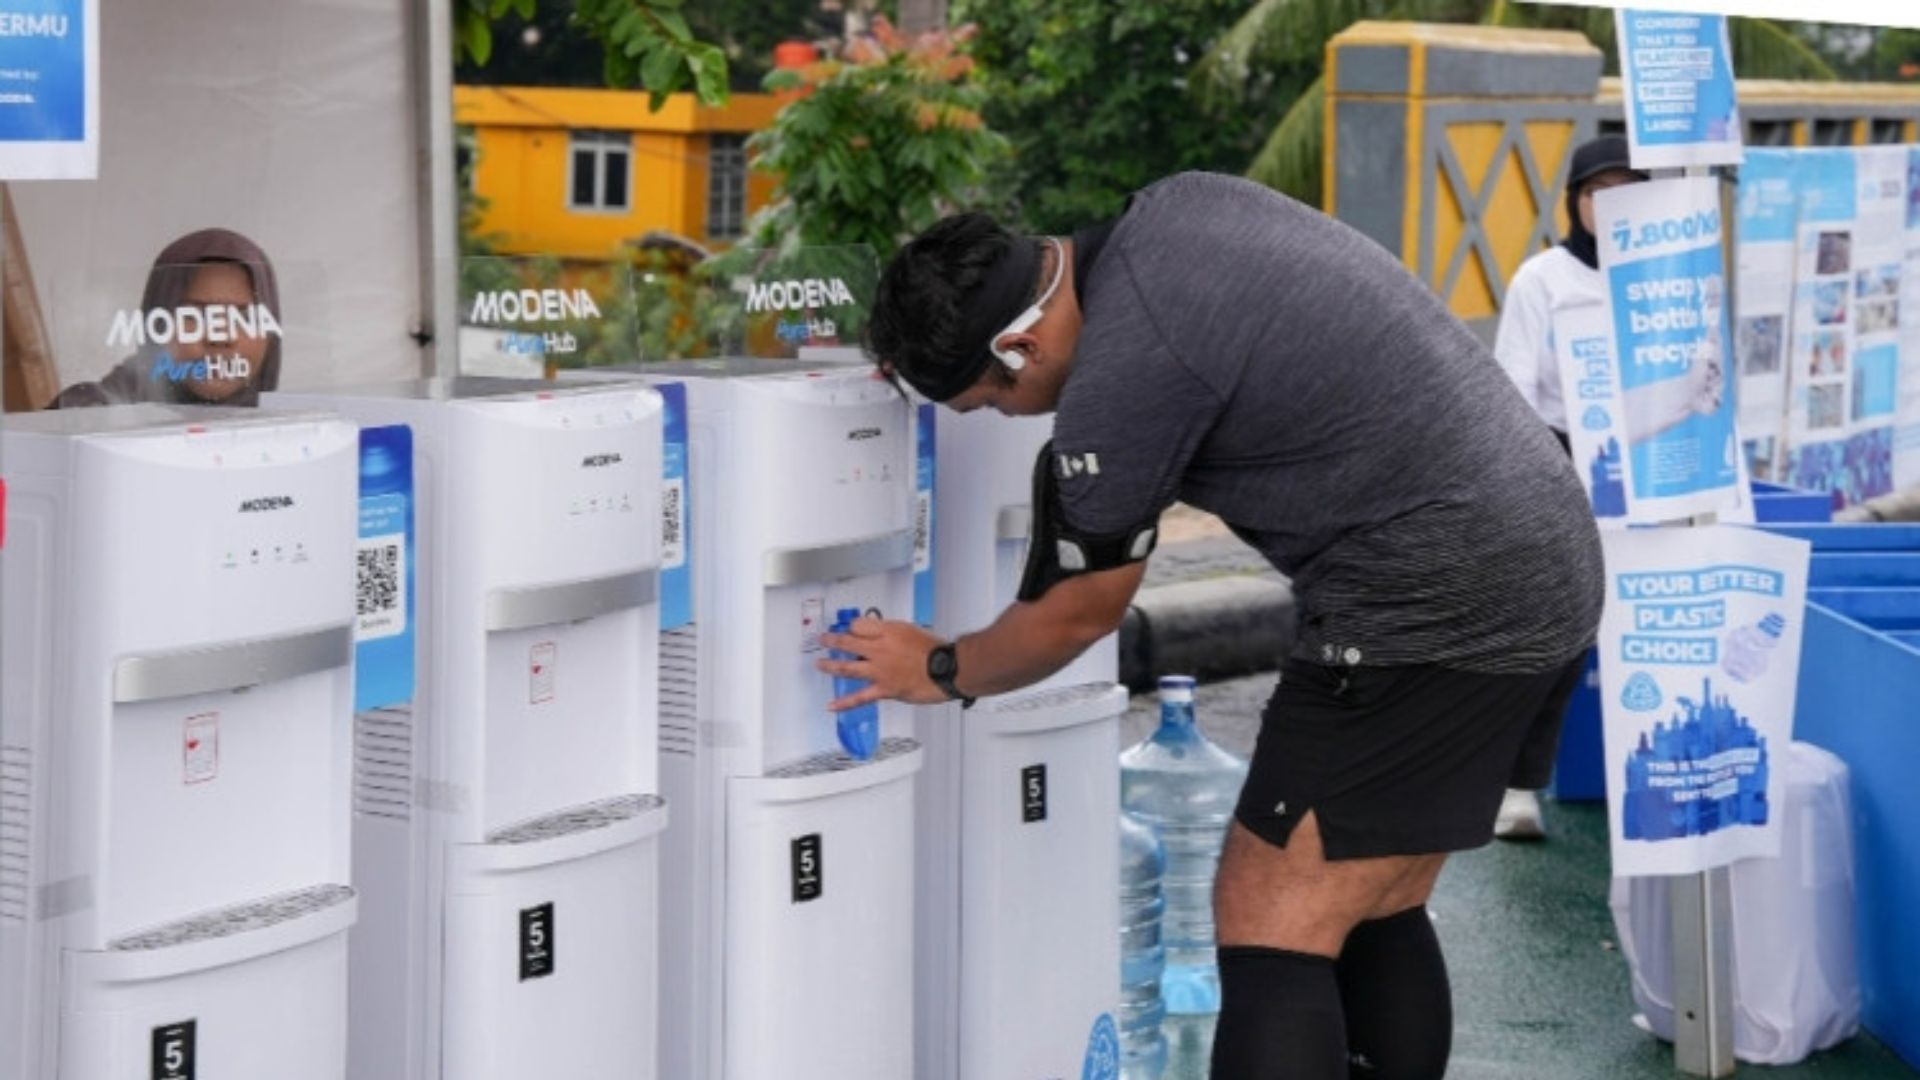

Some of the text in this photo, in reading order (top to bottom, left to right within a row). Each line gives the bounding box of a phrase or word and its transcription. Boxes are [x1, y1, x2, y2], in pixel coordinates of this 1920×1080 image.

[471, 288, 602, 323] MODENA
[745, 277, 855, 313] MODENA
[106, 303, 283, 346] MODENA
[152, 351, 250, 383] PureHub
[239, 496, 294, 513] MODENA
[1621, 574, 1694, 597] YOUR
[1026, 777, 1041, 798] 5
[800, 848, 815, 872] 5
[529, 921, 545, 946] 5
[165, 1040, 183, 1070] 5
